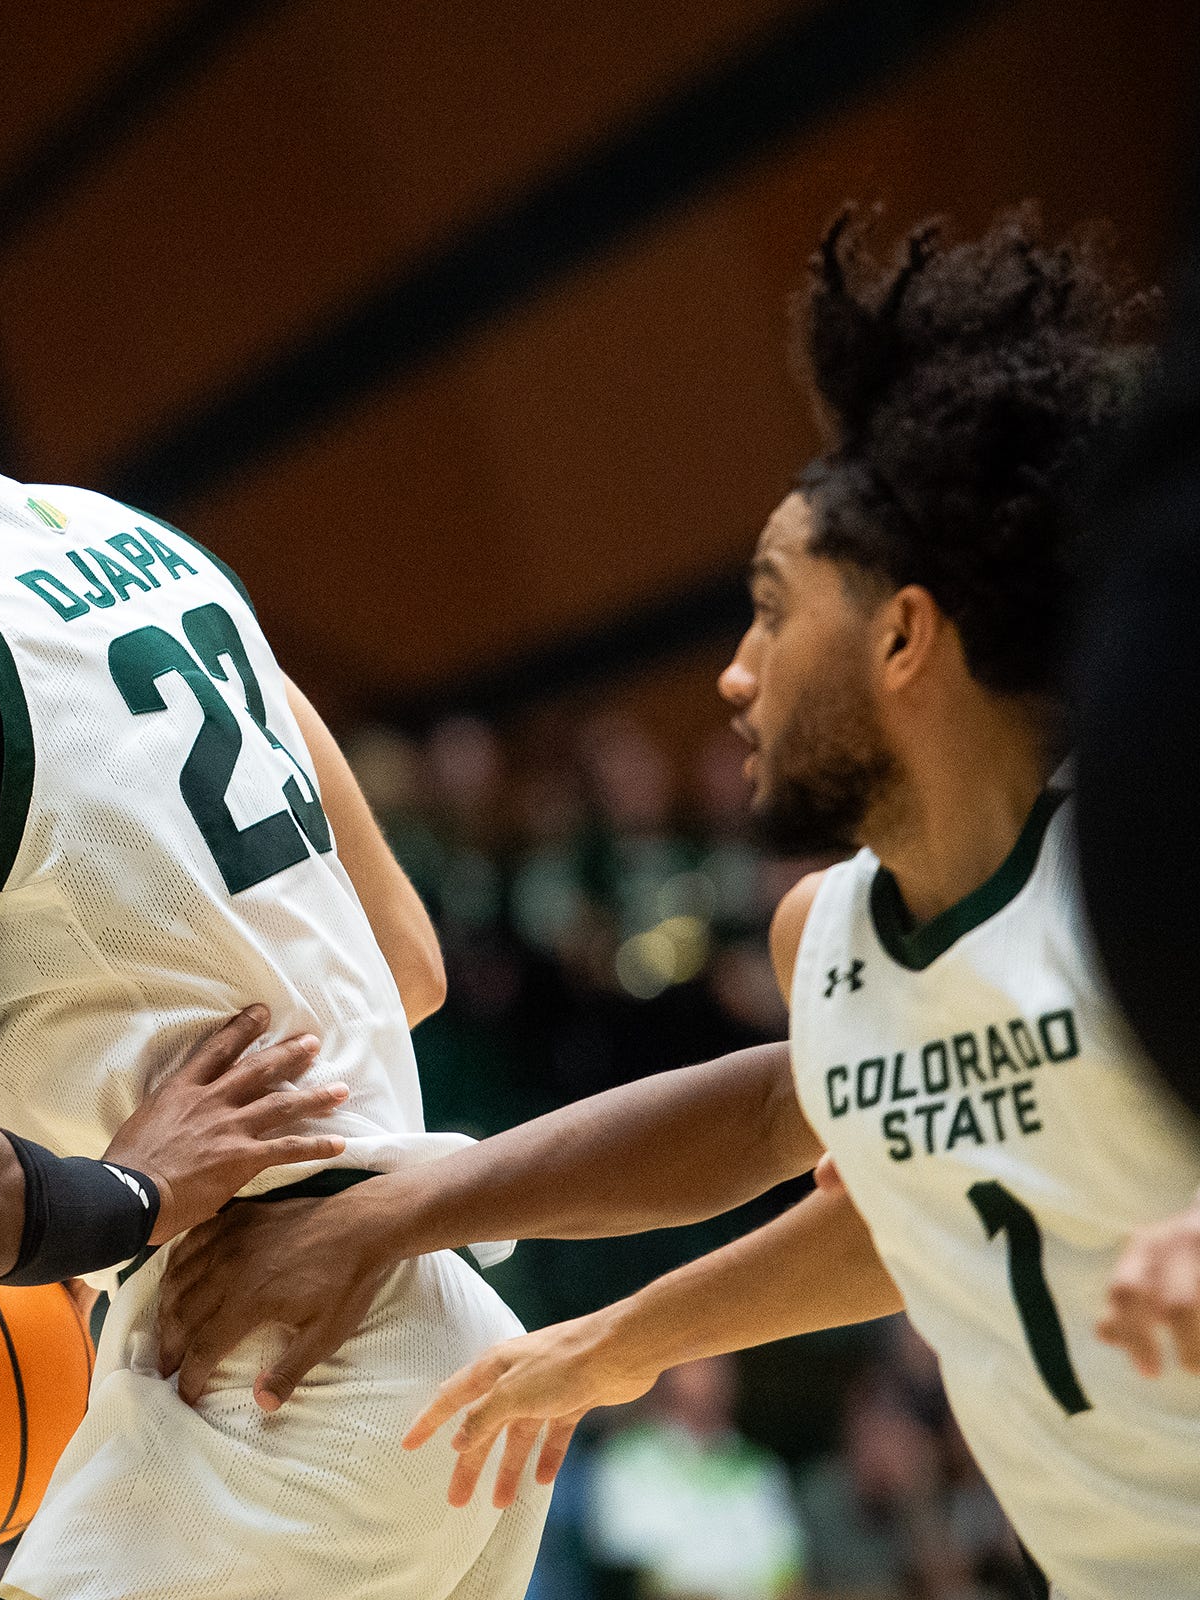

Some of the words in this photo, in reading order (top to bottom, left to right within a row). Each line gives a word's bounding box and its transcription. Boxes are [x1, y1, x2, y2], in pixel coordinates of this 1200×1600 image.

[14, 526, 199, 622] DJAPA
[824, 1006, 1082, 1120] COLORADO
[881, 1079, 1044, 1163] STATE
[966, 1178, 1095, 1418] 1
